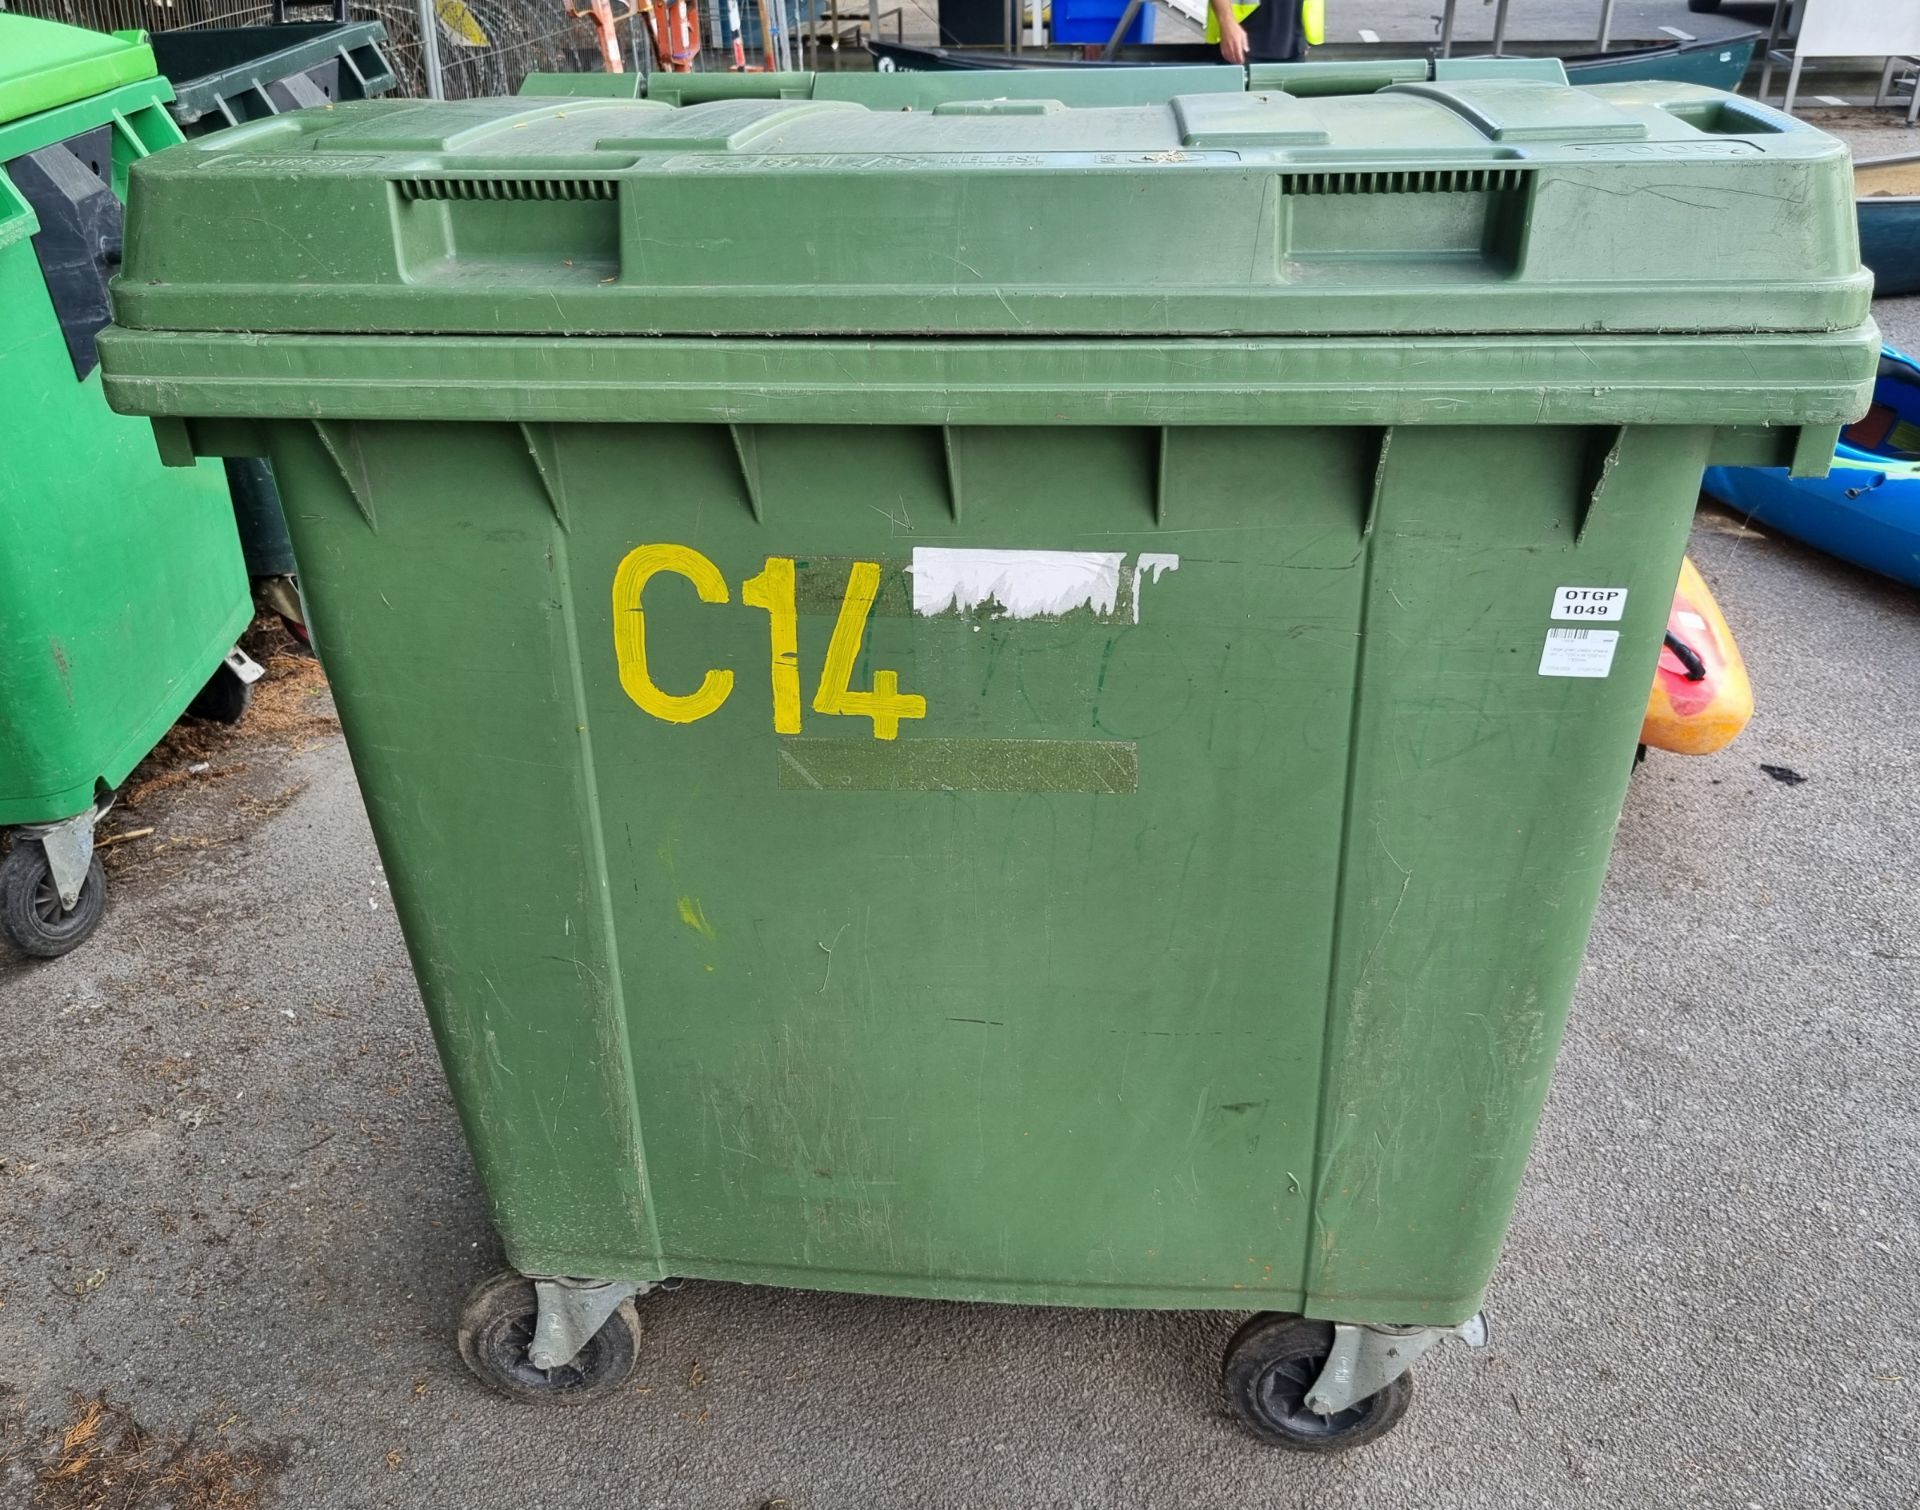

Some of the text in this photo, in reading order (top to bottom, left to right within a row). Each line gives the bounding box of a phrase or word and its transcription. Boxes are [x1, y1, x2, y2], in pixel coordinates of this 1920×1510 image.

[1565, 590, 1619, 601] OTGP
[1563, 605, 1608, 615] 1049
[612, 543, 926, 740] C14
